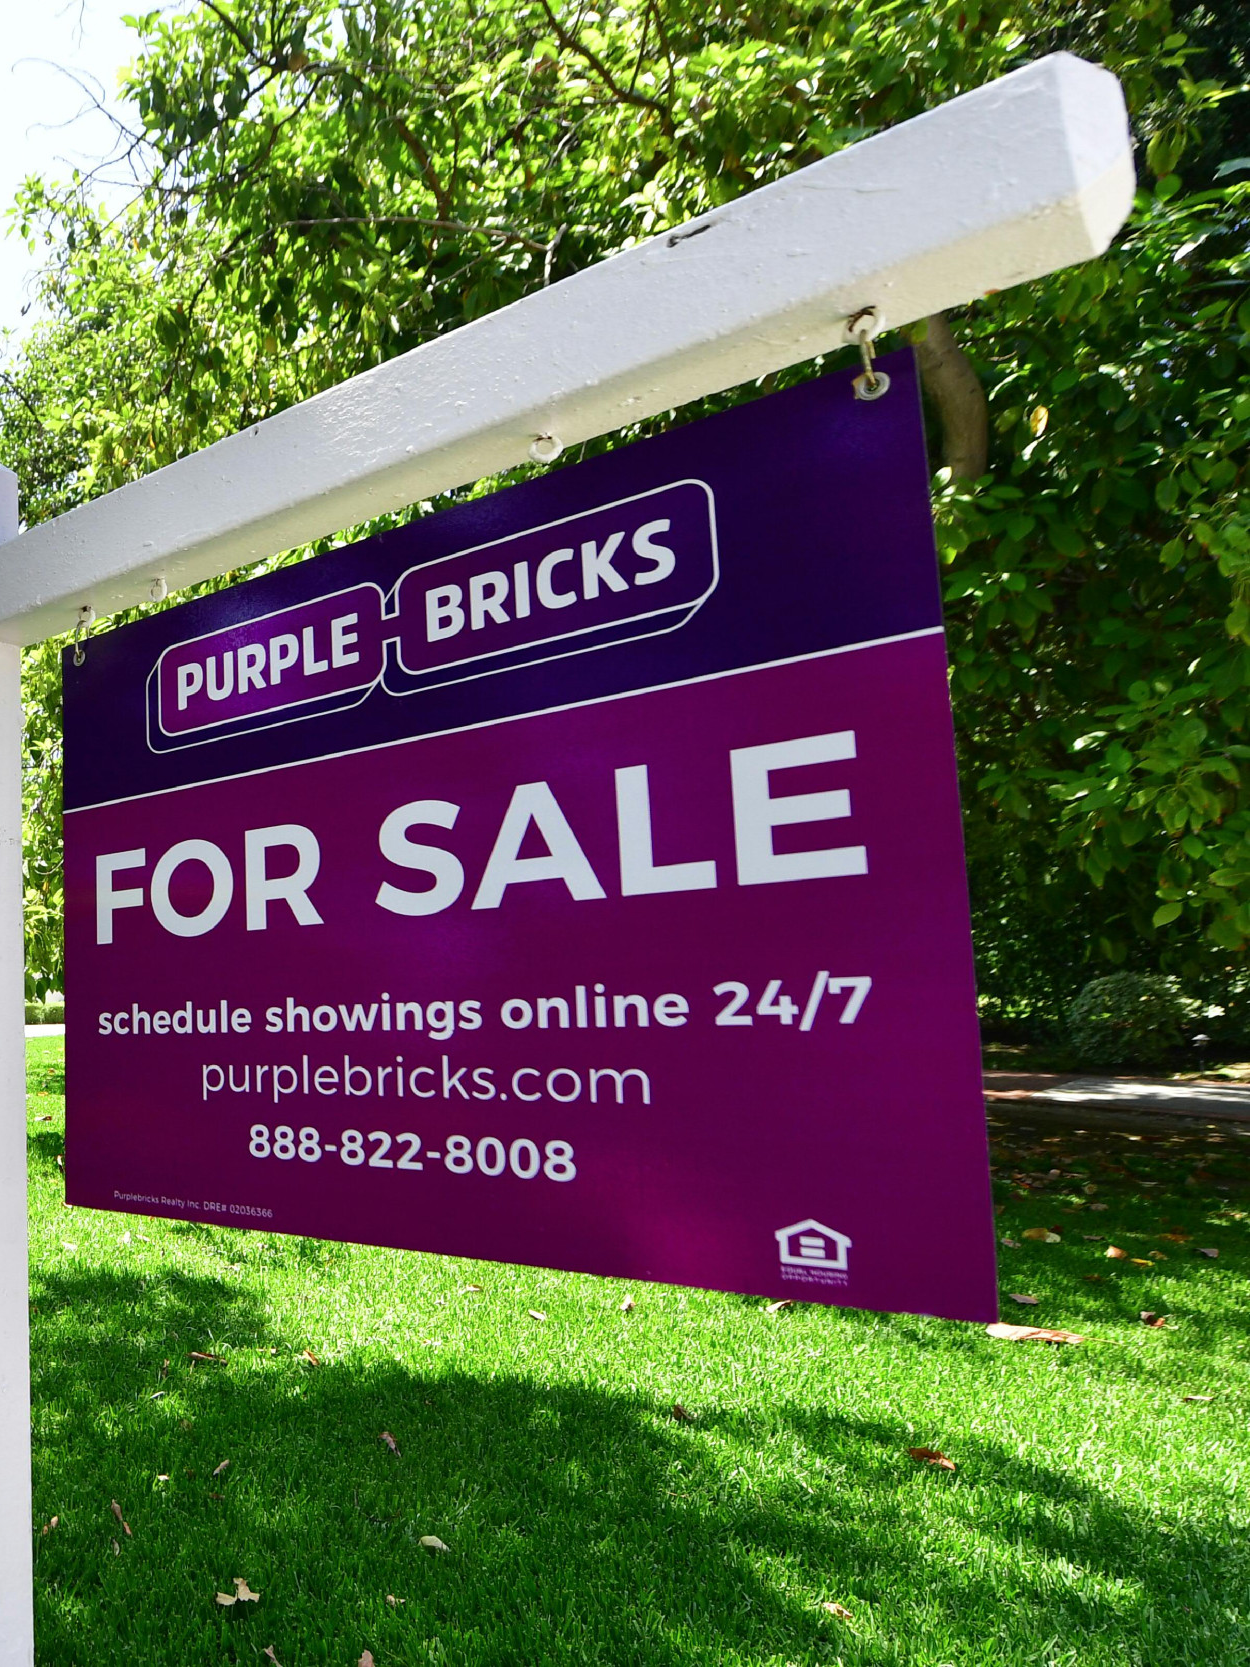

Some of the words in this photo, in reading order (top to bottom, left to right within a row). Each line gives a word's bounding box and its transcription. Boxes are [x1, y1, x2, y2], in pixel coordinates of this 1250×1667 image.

[177, 612, 360, 711] PURPLE
[424, 518, 677, 643] BRICKS
[95, 823, 325, 945] FOR
[374, 729, 869, 917] SALE
[98, 999, 252, 1035] schedule
[265, 992, 483, 1041] showings
[500, 983, 690, 1030] online
[713, 970, 872, 1032] 24/7
[202, 1054, 651, 1105] purplebricks.com
[248, 1124, 577, 1182] 888-822-8008
[113, 1190, 159, 1204] Purplebricks
[160, 1196, 185, 1209] Realty
[186, 1199, 201, 1210] Inc.
[203, 1200, 227, 1212] DRE#
[229, 1203, 273, 1218] 02036366
